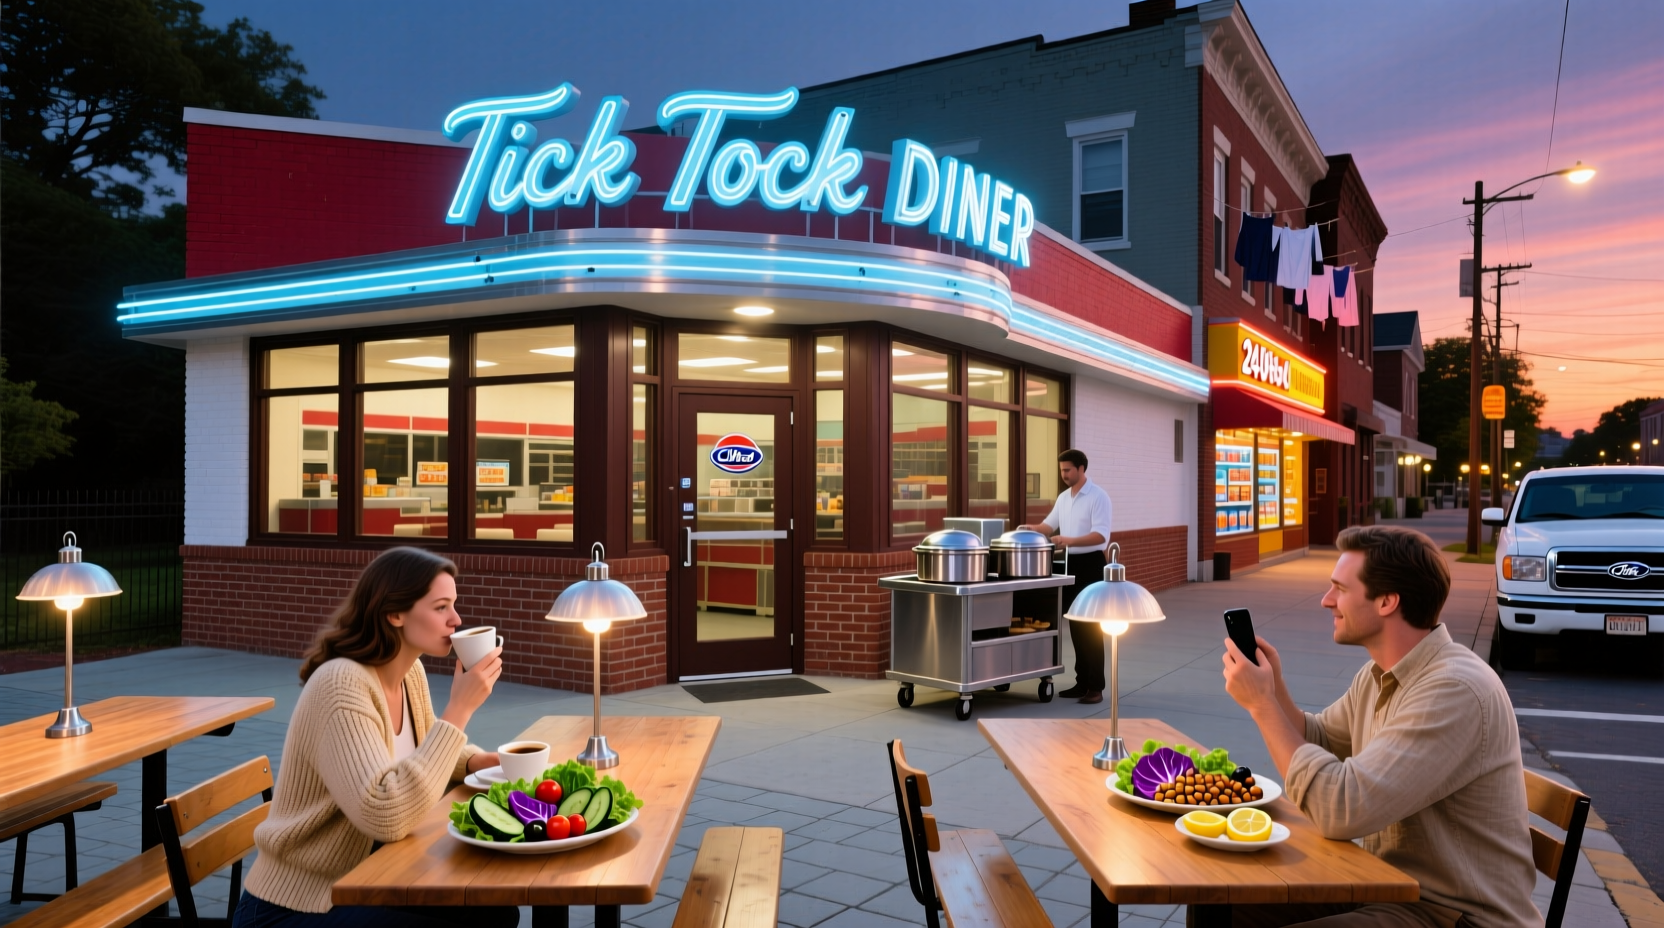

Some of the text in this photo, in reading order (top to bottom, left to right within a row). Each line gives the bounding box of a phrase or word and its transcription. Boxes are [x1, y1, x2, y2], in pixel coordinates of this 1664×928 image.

[442, 82, 1034, 268] Tick Tock DINER
